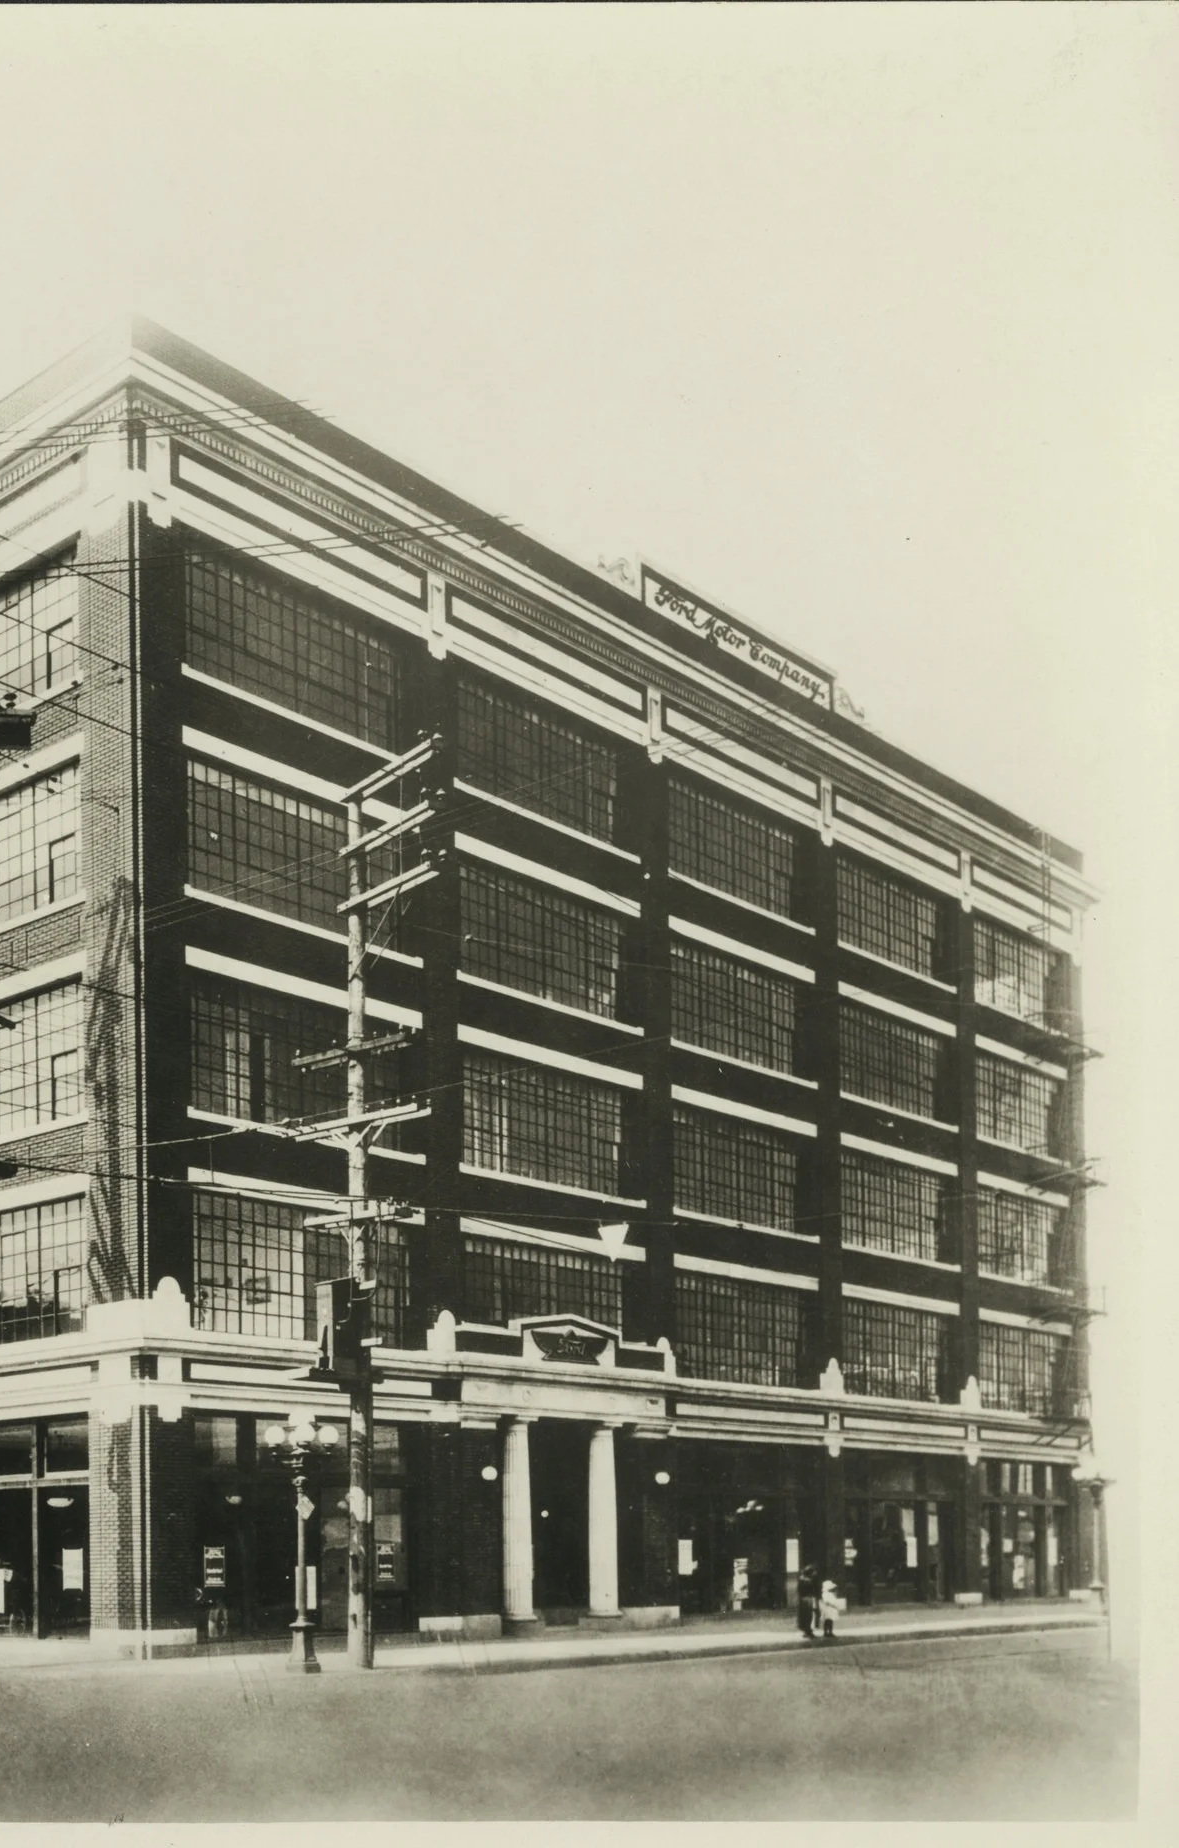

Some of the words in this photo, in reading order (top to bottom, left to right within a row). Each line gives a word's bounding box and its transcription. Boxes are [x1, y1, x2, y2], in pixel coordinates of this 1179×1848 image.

[654, 586, 697, 624] Ford
[696, 616, 746, 649] Motor
[749, 637, 825, 700] Company
[557, 1338, 586, 1356] Ford
